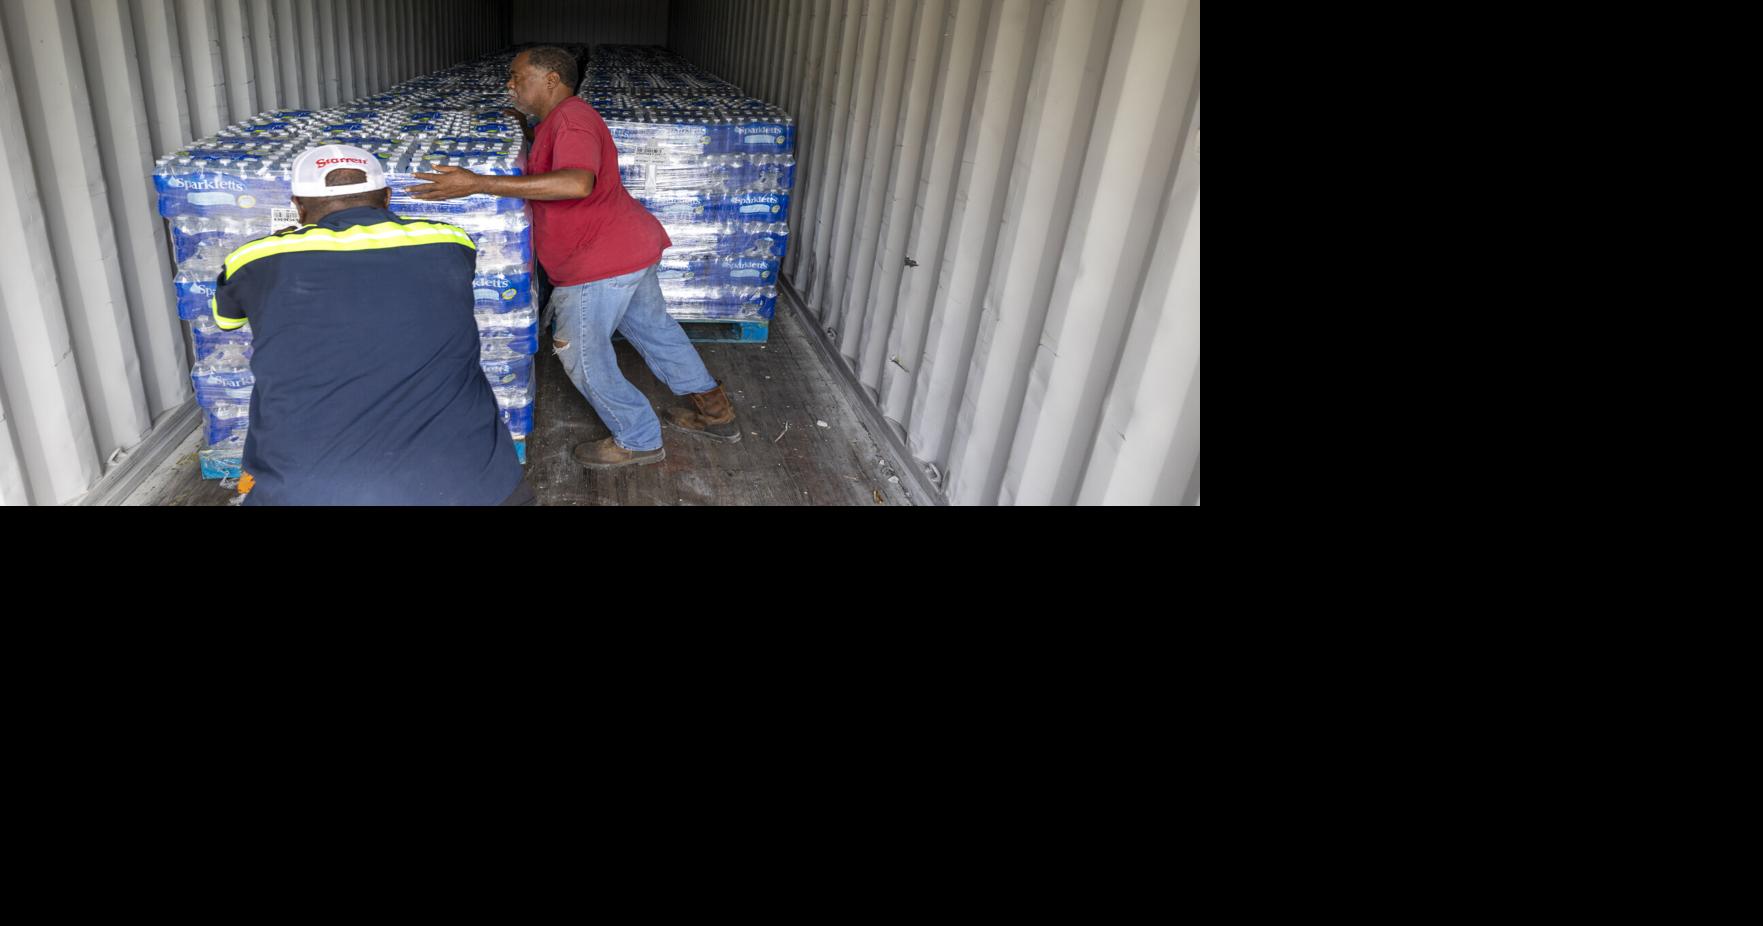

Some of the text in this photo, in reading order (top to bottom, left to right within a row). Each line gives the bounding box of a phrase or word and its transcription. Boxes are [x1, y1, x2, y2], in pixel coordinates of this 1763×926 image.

[177, 177, 244, 192] Sparkletts
[472, 278, 509, 288] kletts
[215, 375, 255, 387] Sparkl
